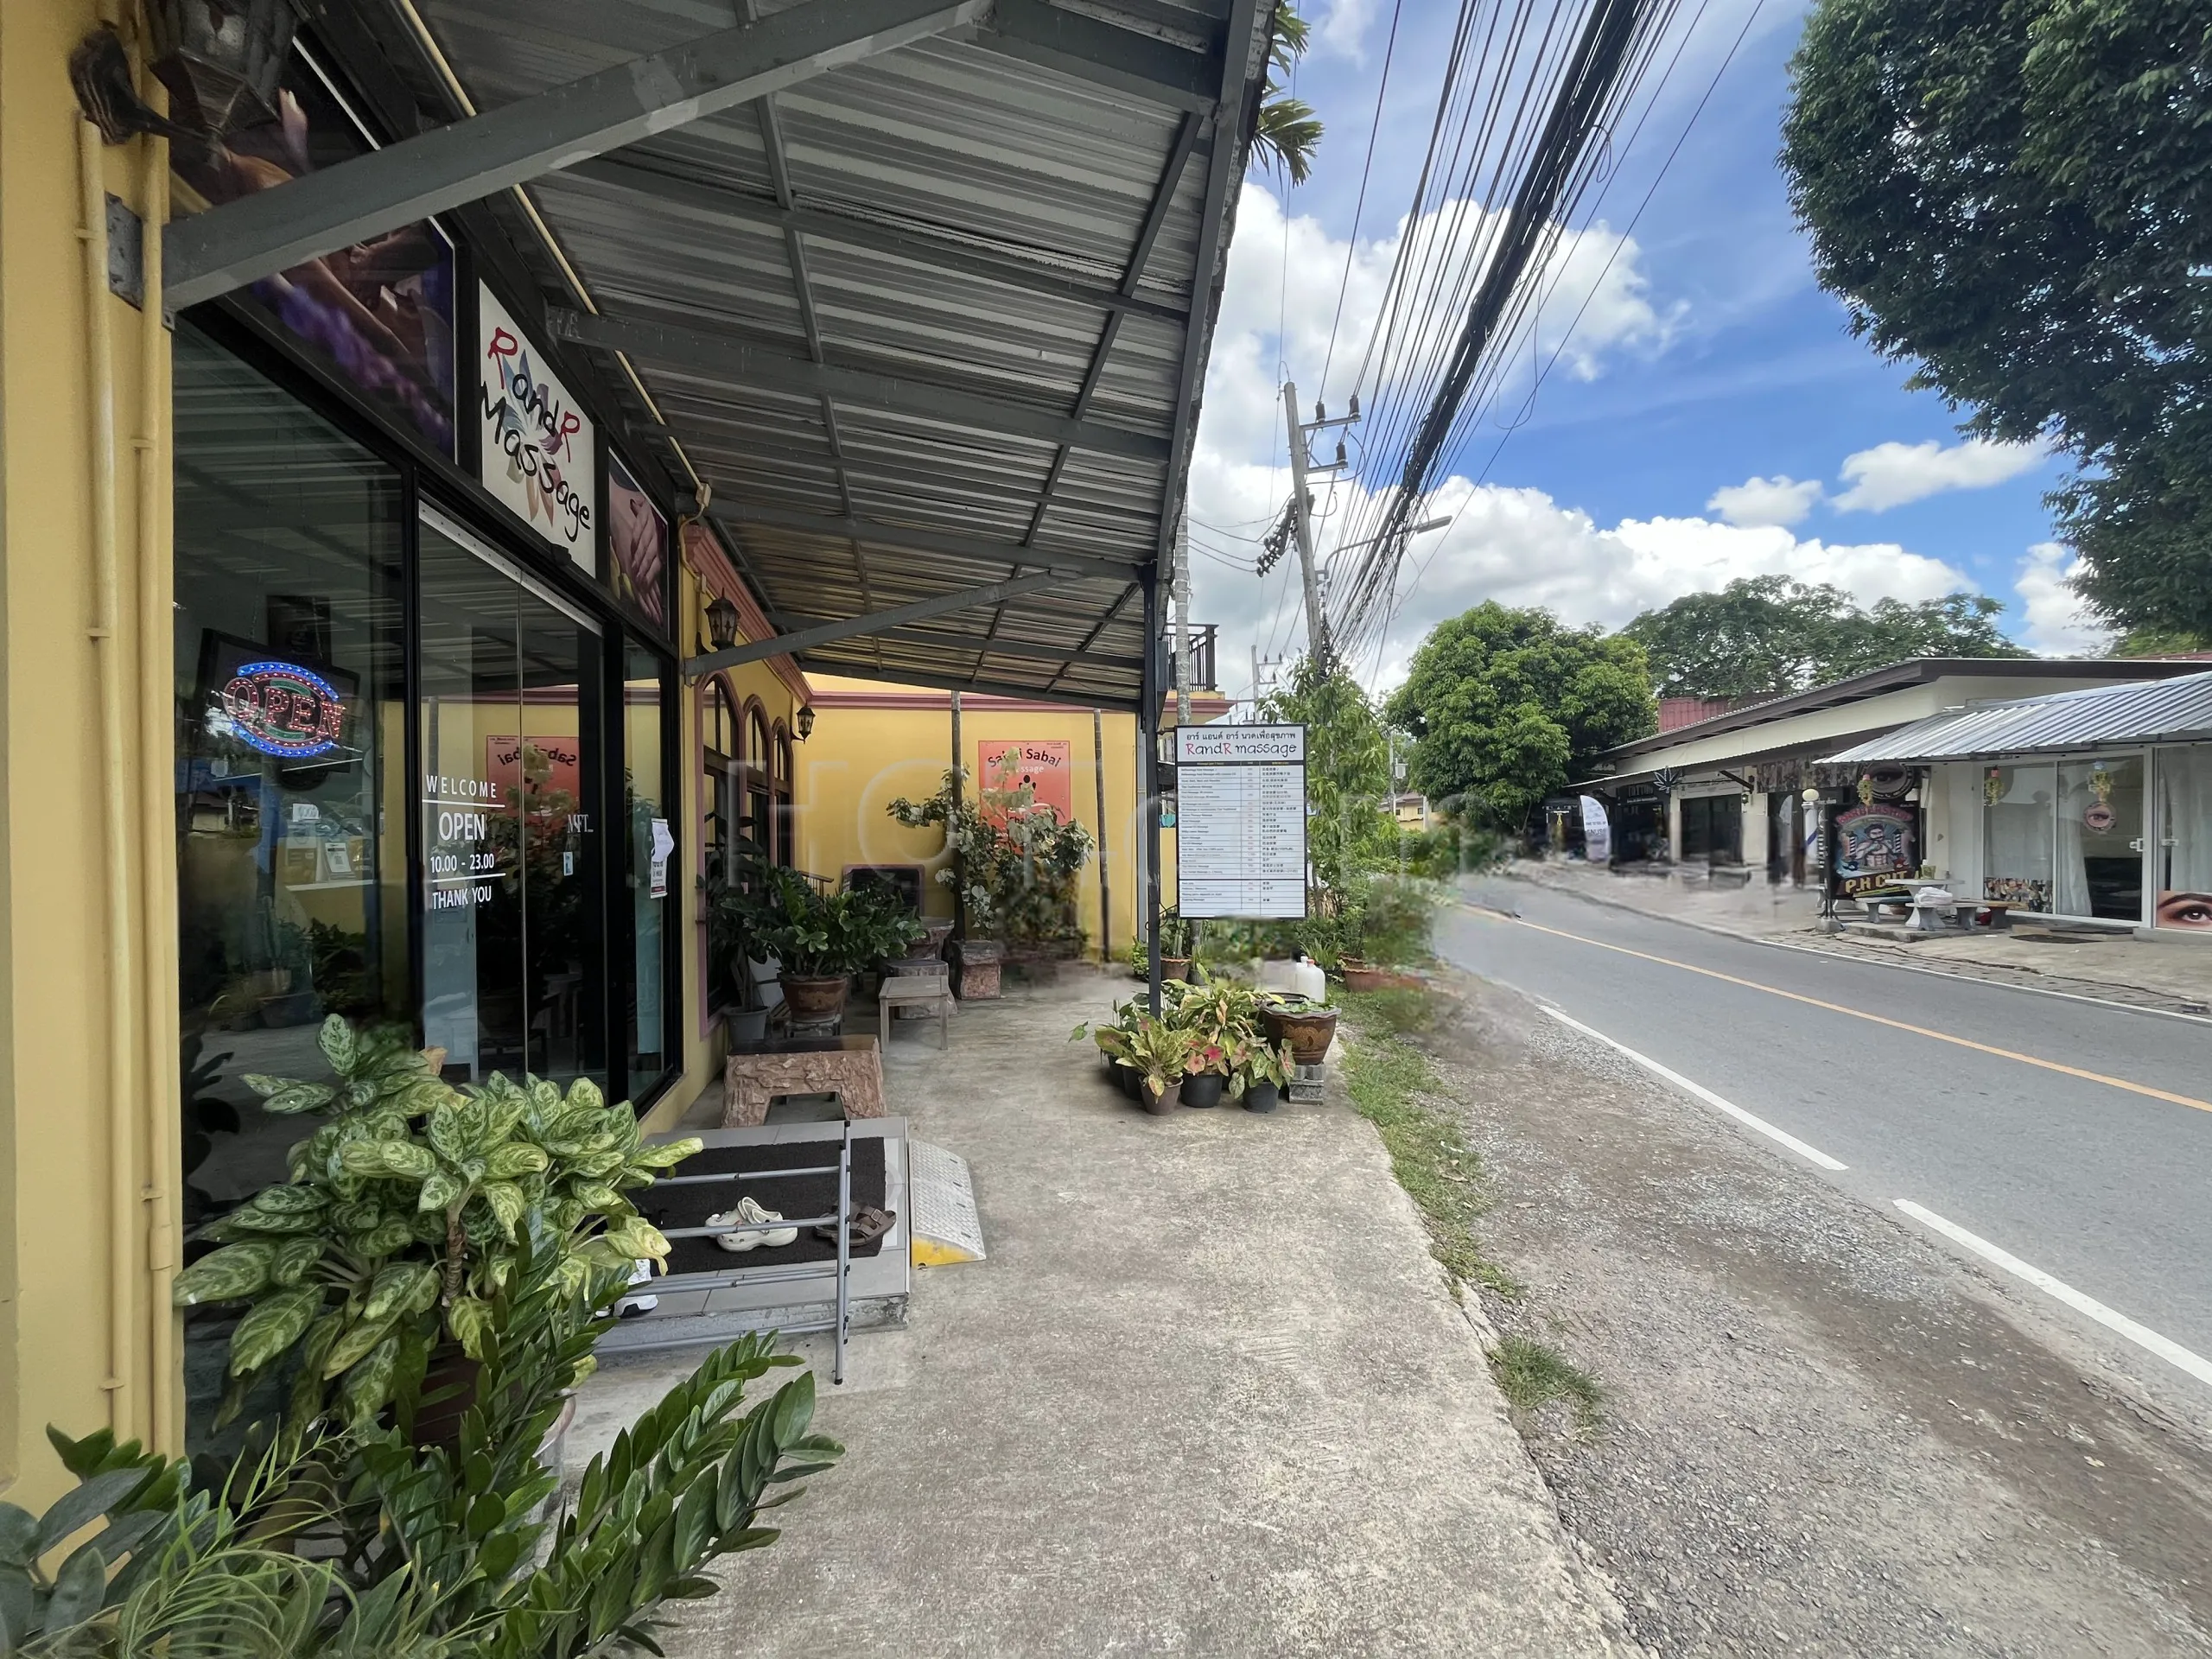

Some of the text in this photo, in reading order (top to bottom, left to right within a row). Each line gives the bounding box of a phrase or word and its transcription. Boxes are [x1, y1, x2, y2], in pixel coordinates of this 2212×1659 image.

[481, 380, 591, 543] Massage
[223, 677, 346, 739] OPEN
[1026, 748, 1061, 767] Sabai
[1185, 742, 1297, 758] RandR massage
[426, 774, 497, 798] WELCOME
[439, 811, 486, 841] OPEN
[430, 855, 458, 874] 10.00
[469, 853, 495, 871] 23.00
[432, 885, 492, 910] THANK YOU
